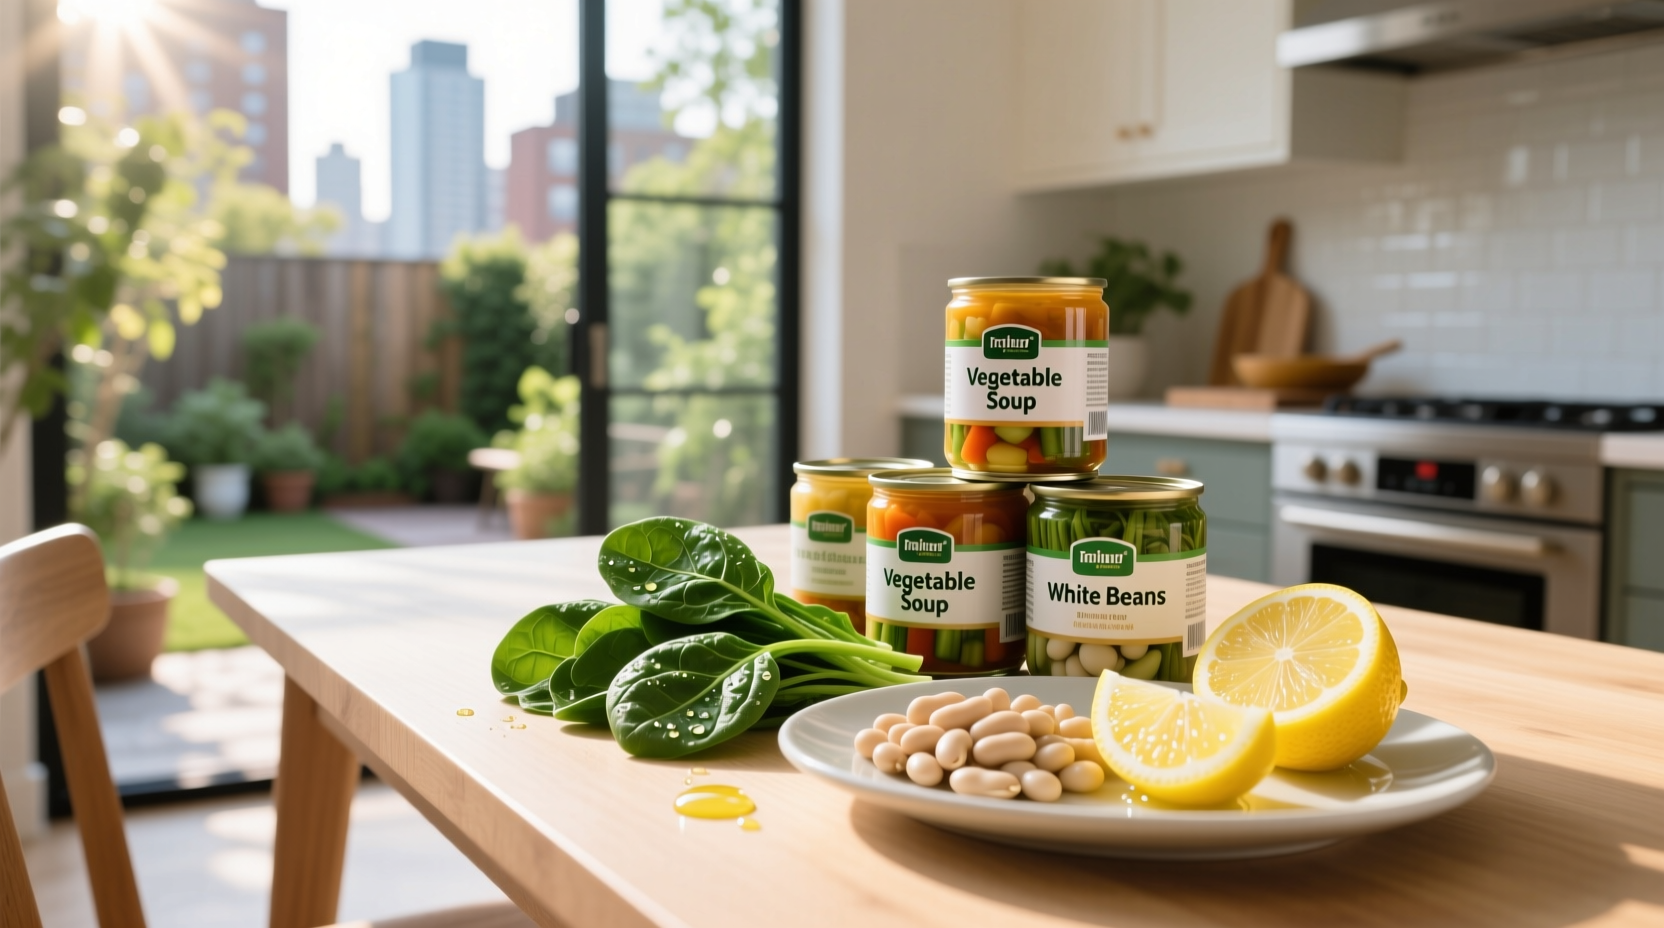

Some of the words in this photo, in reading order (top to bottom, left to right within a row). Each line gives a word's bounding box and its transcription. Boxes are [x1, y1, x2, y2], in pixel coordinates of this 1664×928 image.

[966, 367, 1062, 390] Vegetable
[986, 391, 1037, 415] Soup
[883, 568, 976, 596] Vegetable
[1047, 581, 1101, 605] White
[1106, 586, 1166, 606] Beans
[900, 594, 949, 618] Soup
